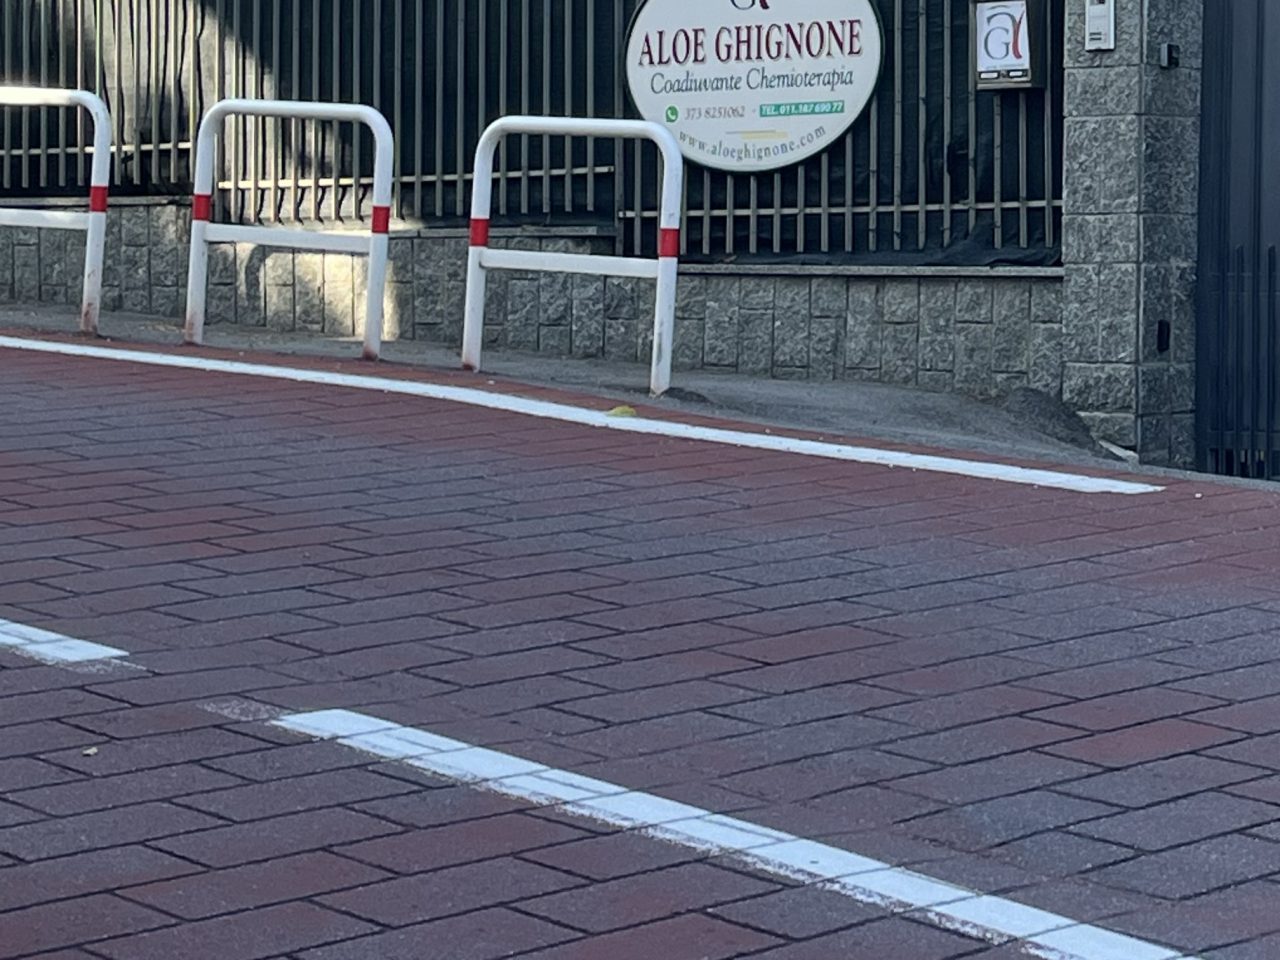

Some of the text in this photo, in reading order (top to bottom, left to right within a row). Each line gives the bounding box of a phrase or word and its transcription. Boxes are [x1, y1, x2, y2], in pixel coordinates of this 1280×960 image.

[638, 19, 863, 67] ALOE GHIGNONE
[650, 66, 855, 95] Coadiuvante Chemioterapia
[761, 104, 779, 116] TEL.
[678, 124, 826, 162] www.aloeghignone.com
